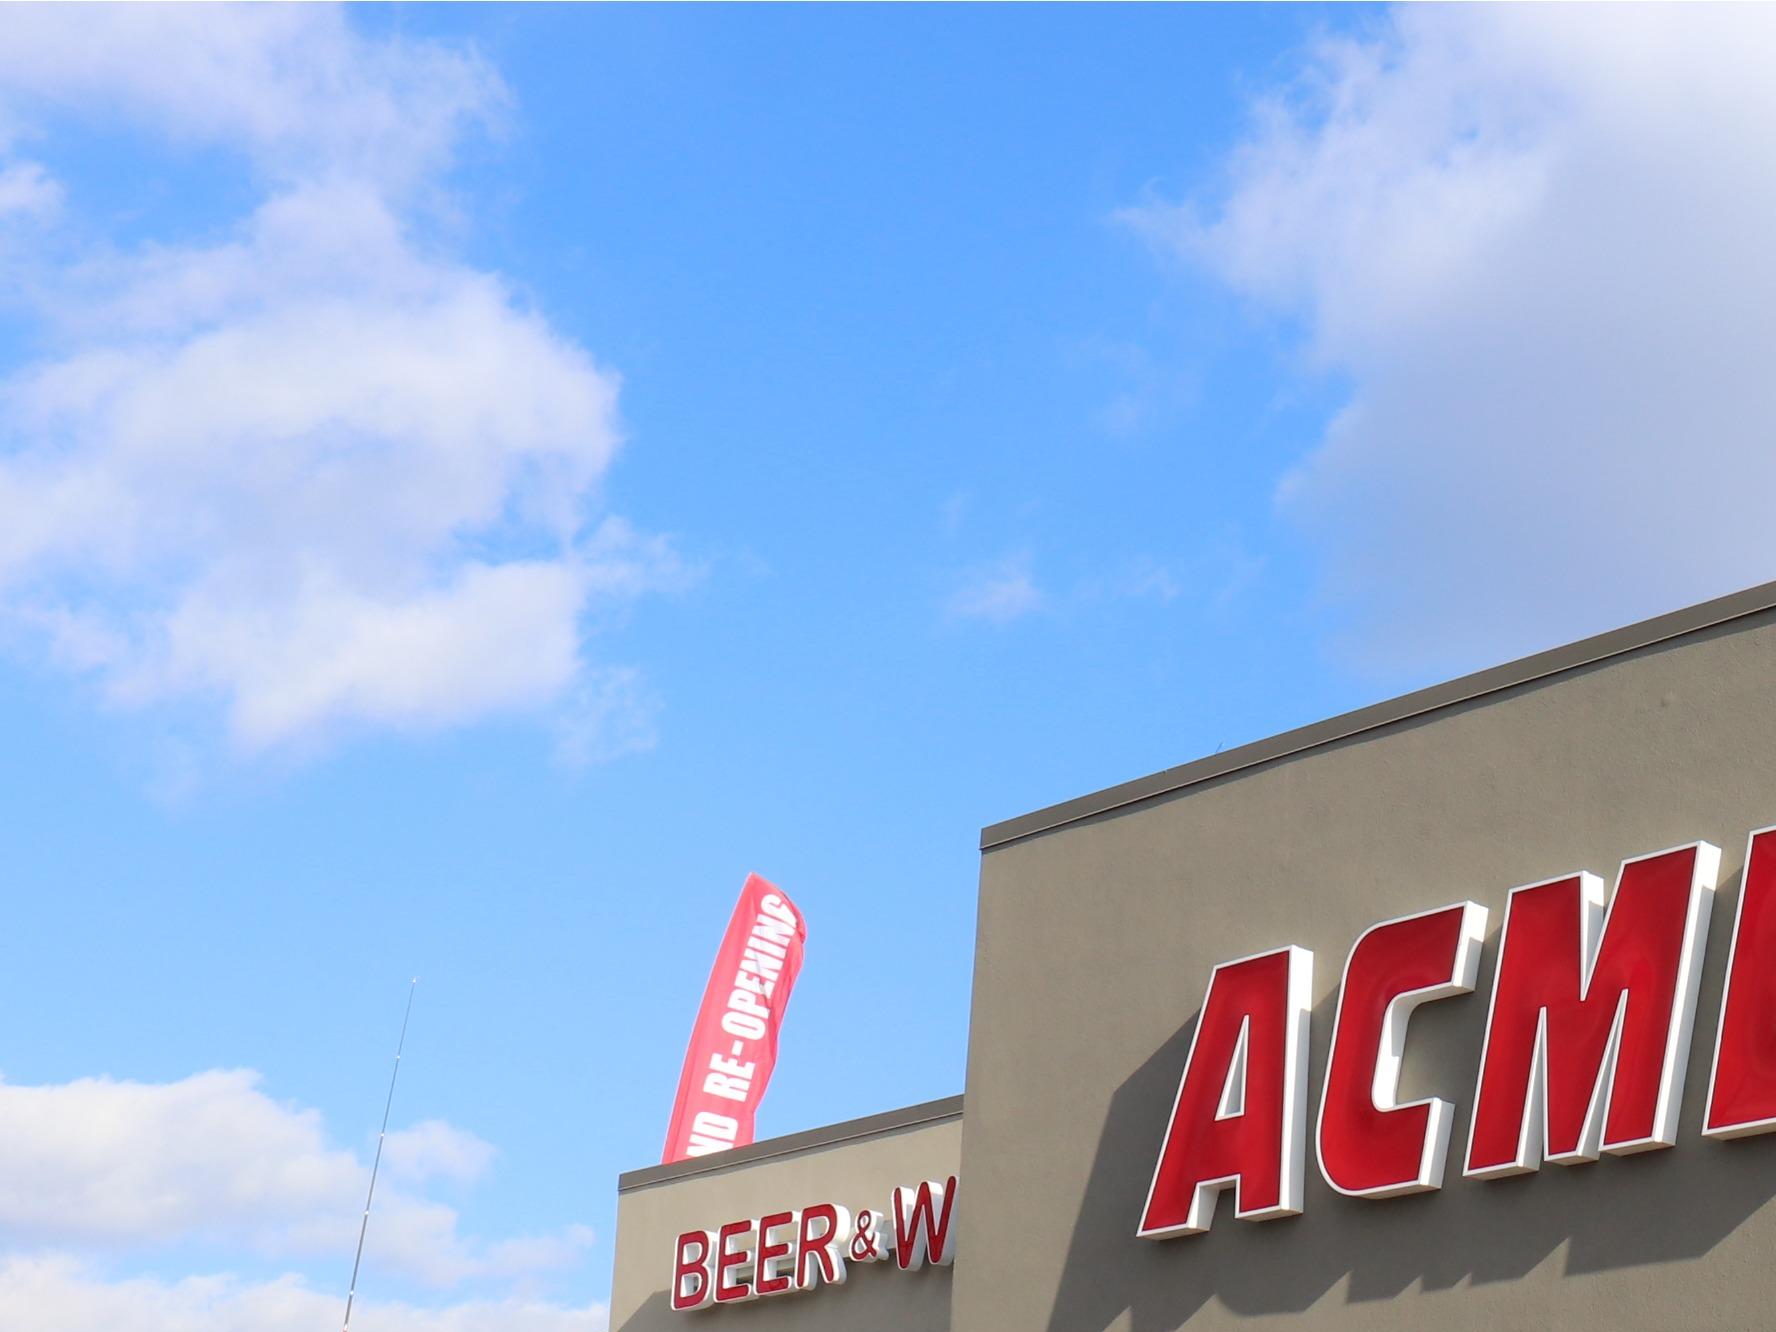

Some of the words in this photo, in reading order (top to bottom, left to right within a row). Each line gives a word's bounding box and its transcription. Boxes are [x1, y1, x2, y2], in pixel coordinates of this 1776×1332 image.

[703, 894, 797, 1102] RE-OPENING
[670, 1202, 851, 1312] BEER
[849, 1208, 883, 1263] &
